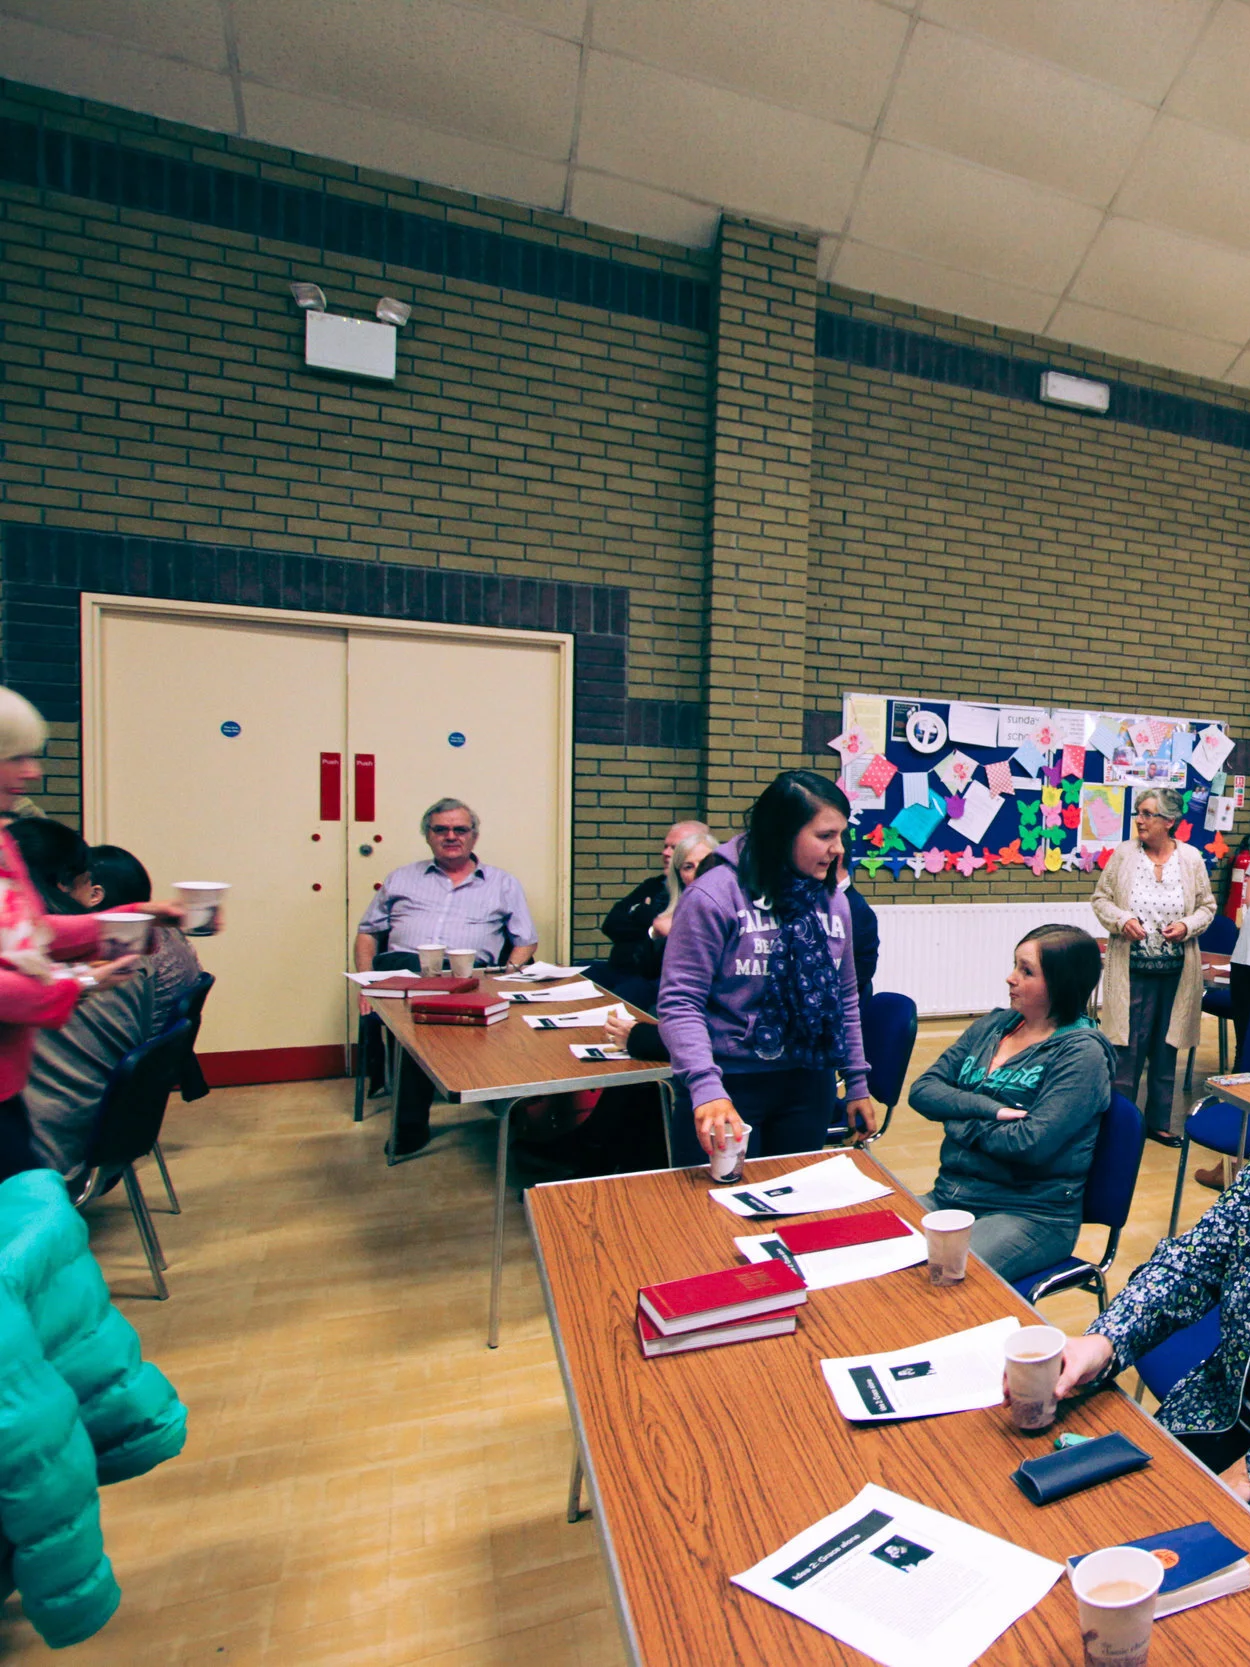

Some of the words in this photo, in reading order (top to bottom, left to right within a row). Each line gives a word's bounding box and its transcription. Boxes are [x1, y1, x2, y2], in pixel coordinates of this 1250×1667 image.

[1007, 732, 1029, 741] sch
[817, 1547, 842, 1563] Grace
[840, 1534, 861, 1549] alone
